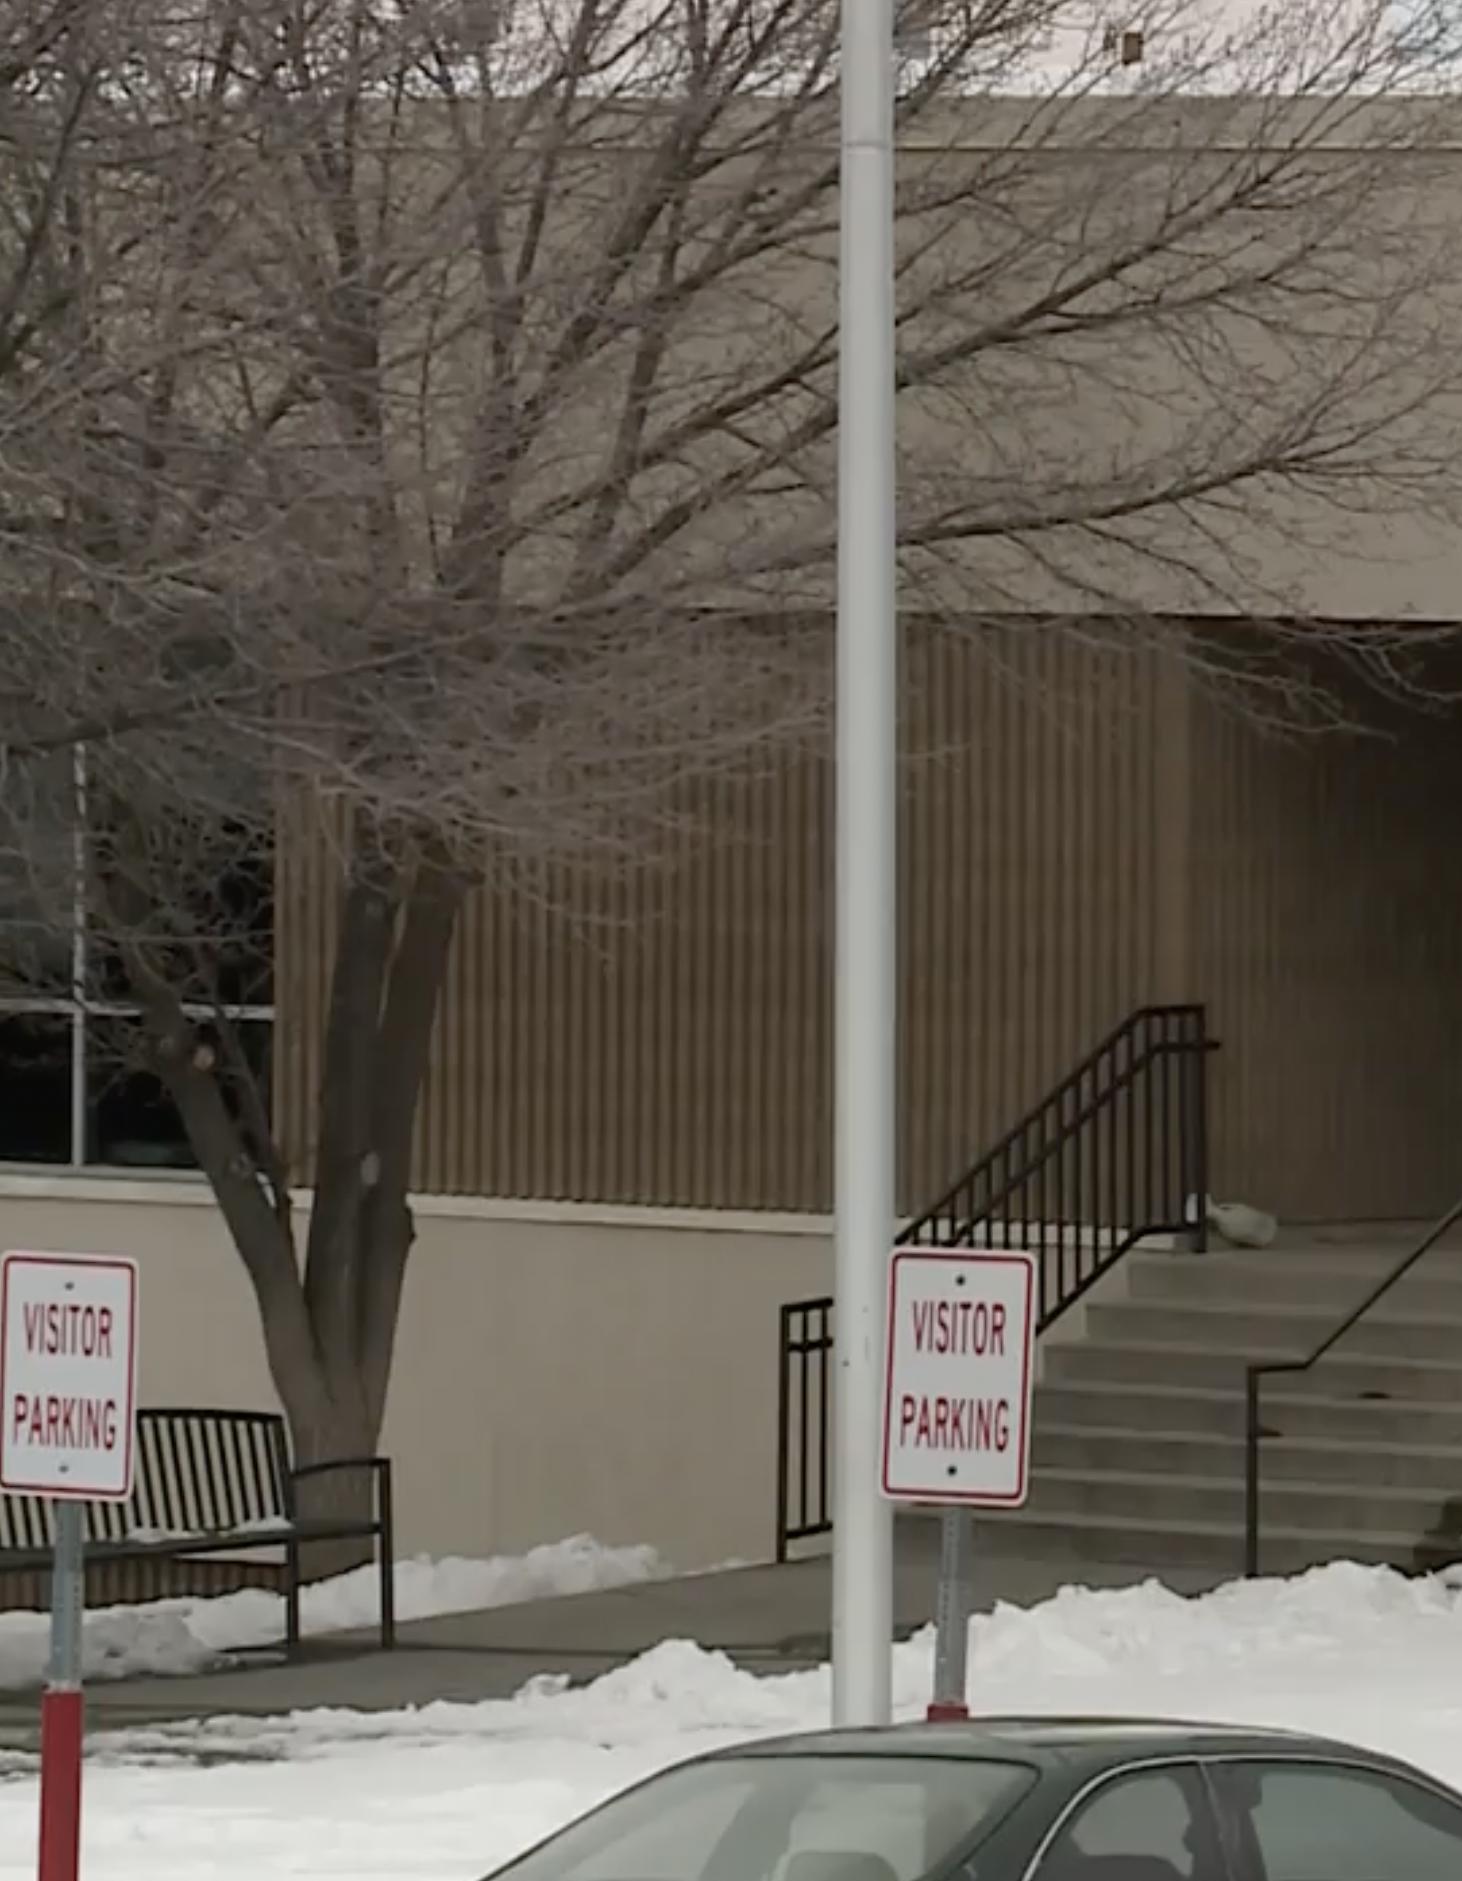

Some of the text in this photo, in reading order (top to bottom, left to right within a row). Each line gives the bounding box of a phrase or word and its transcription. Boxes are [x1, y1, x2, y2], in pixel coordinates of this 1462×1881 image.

[24, 1302, 112, 1358] VISITOR
[913, 1301, 1006, 1356] VISITOR
[13, 1393, 117, 1451] PARKING
[900, 1395, 1009, 1452] PARKING
